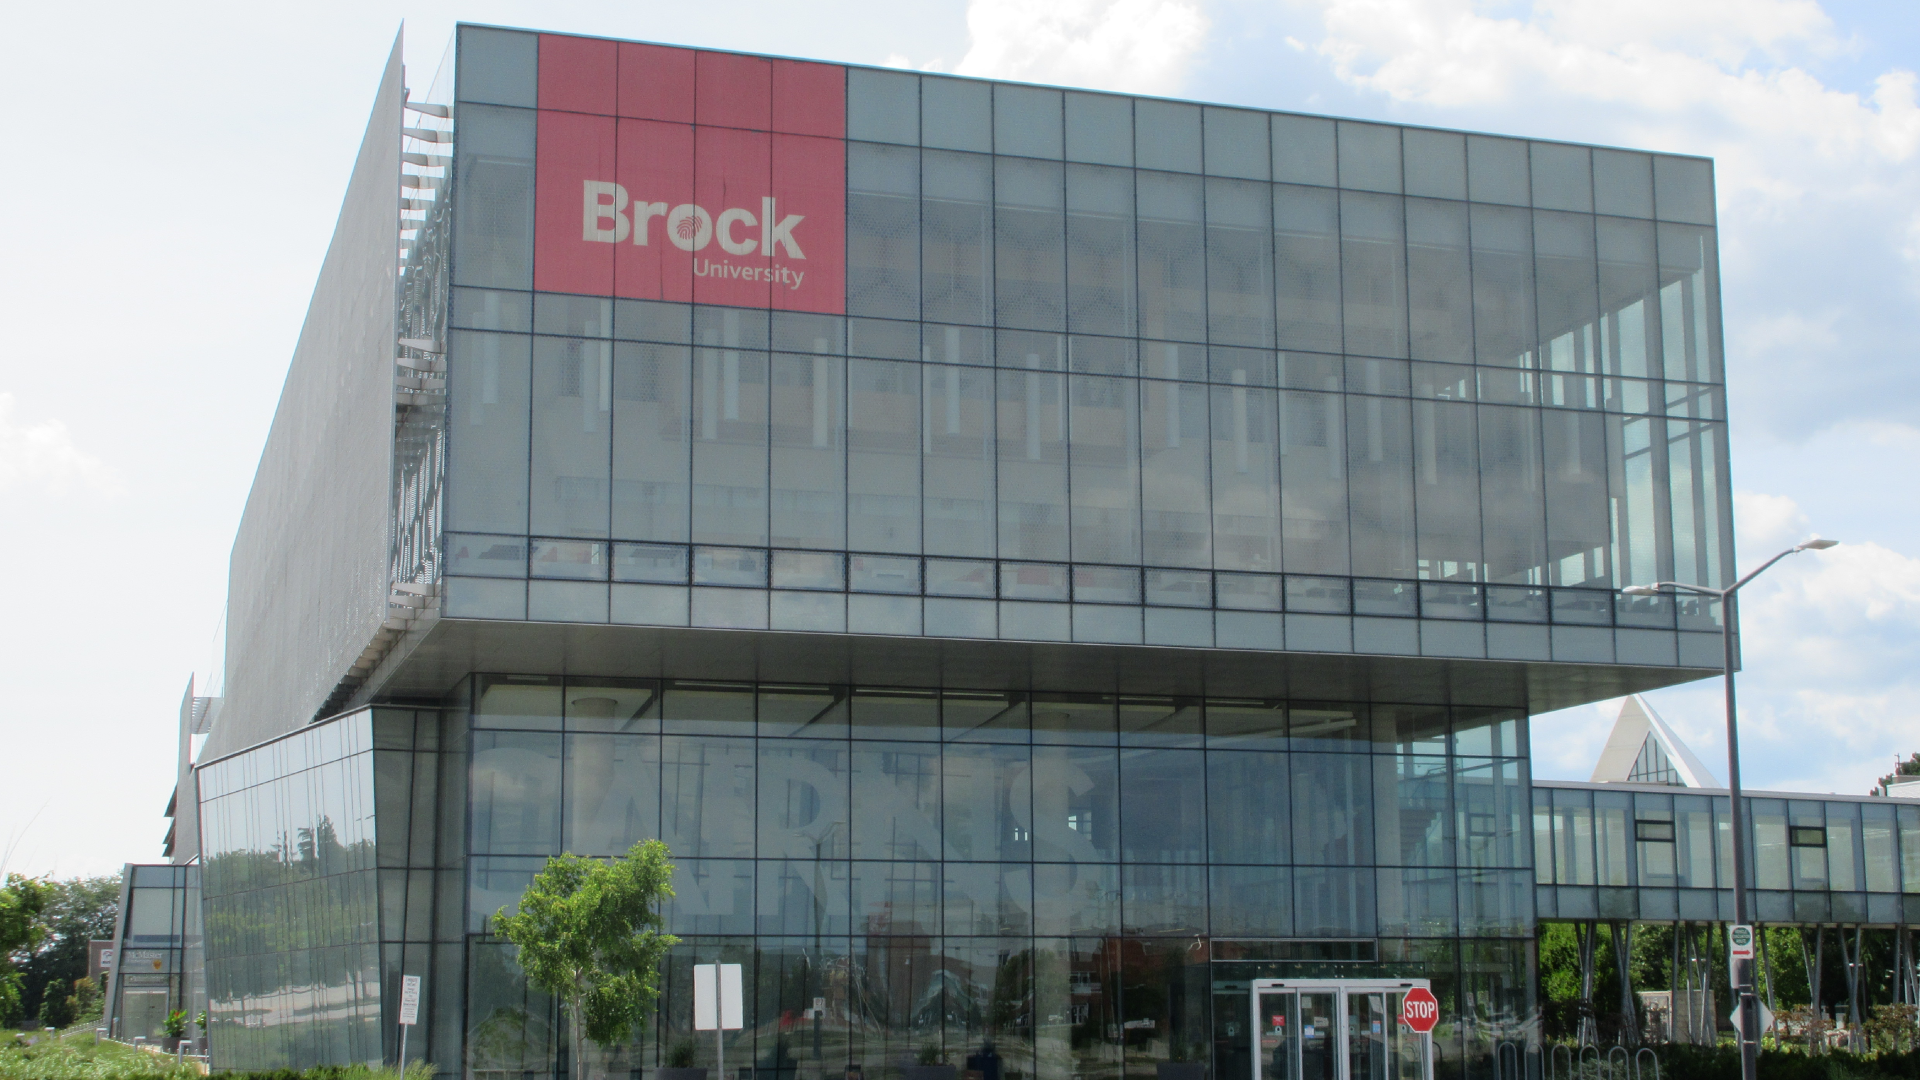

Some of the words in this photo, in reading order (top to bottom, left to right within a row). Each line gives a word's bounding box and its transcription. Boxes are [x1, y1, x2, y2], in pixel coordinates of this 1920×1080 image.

[583, 179, 806, 260] Brock
[693, 258, 805, 290] University
[127, 950, 163, 959] McMaster
[1406, 1001, 1435, 1018] STOP
